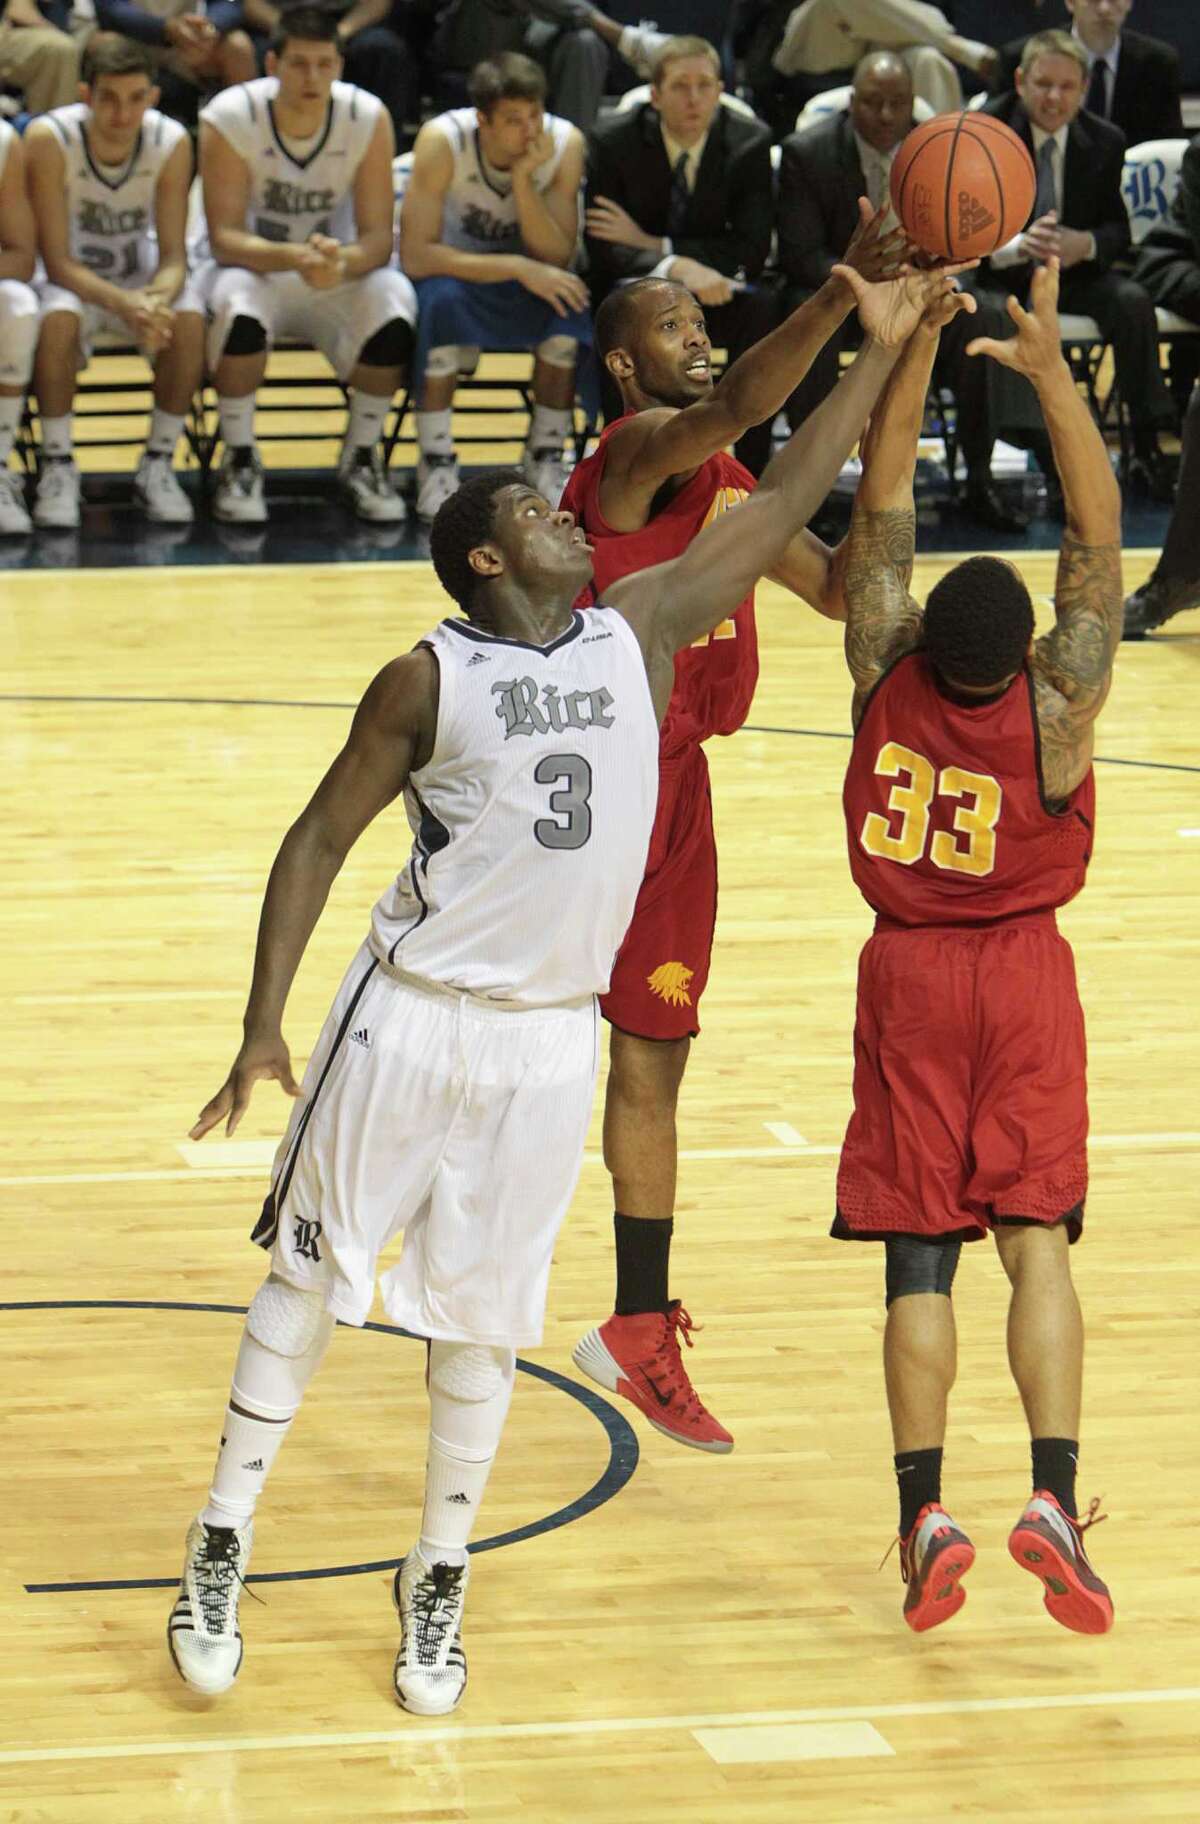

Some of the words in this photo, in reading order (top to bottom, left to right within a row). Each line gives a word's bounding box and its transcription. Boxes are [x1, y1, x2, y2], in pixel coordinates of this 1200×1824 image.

[78, 199, 145, 235] Rice
[263, 178, 335, 215] Rice
[491, 675, 615, 740] Rice
[534, 753, 592, 850] 3
[860, 741, 1003, 877] 33
[292, 1214, 322, 1262] R
